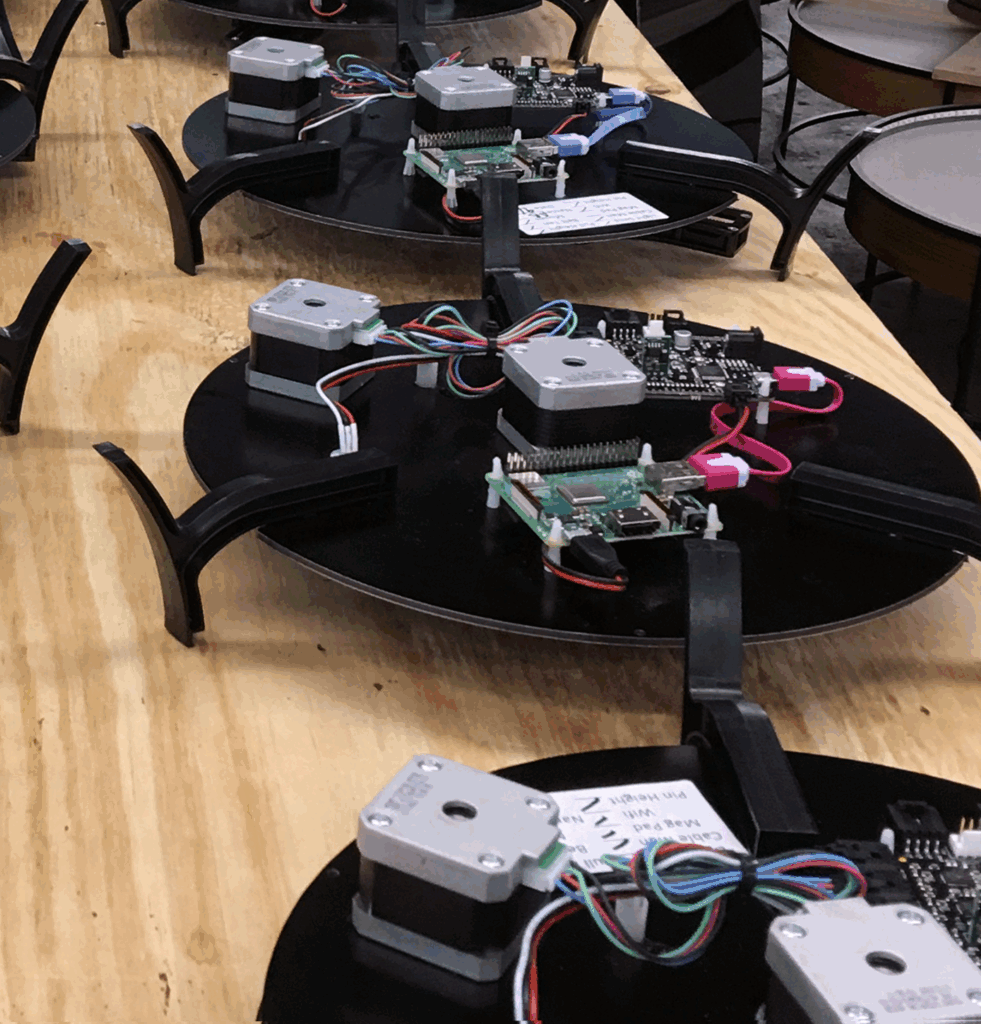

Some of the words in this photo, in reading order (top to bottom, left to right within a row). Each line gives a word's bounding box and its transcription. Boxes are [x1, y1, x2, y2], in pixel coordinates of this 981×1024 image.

[608, 793, 660, 806] Height
[662, 791, 688, 799] Pin
[632, 823, 663, 833] Pad
[663, 818, 702, 829] Mag
[678, 831, 724, 844] Cable
